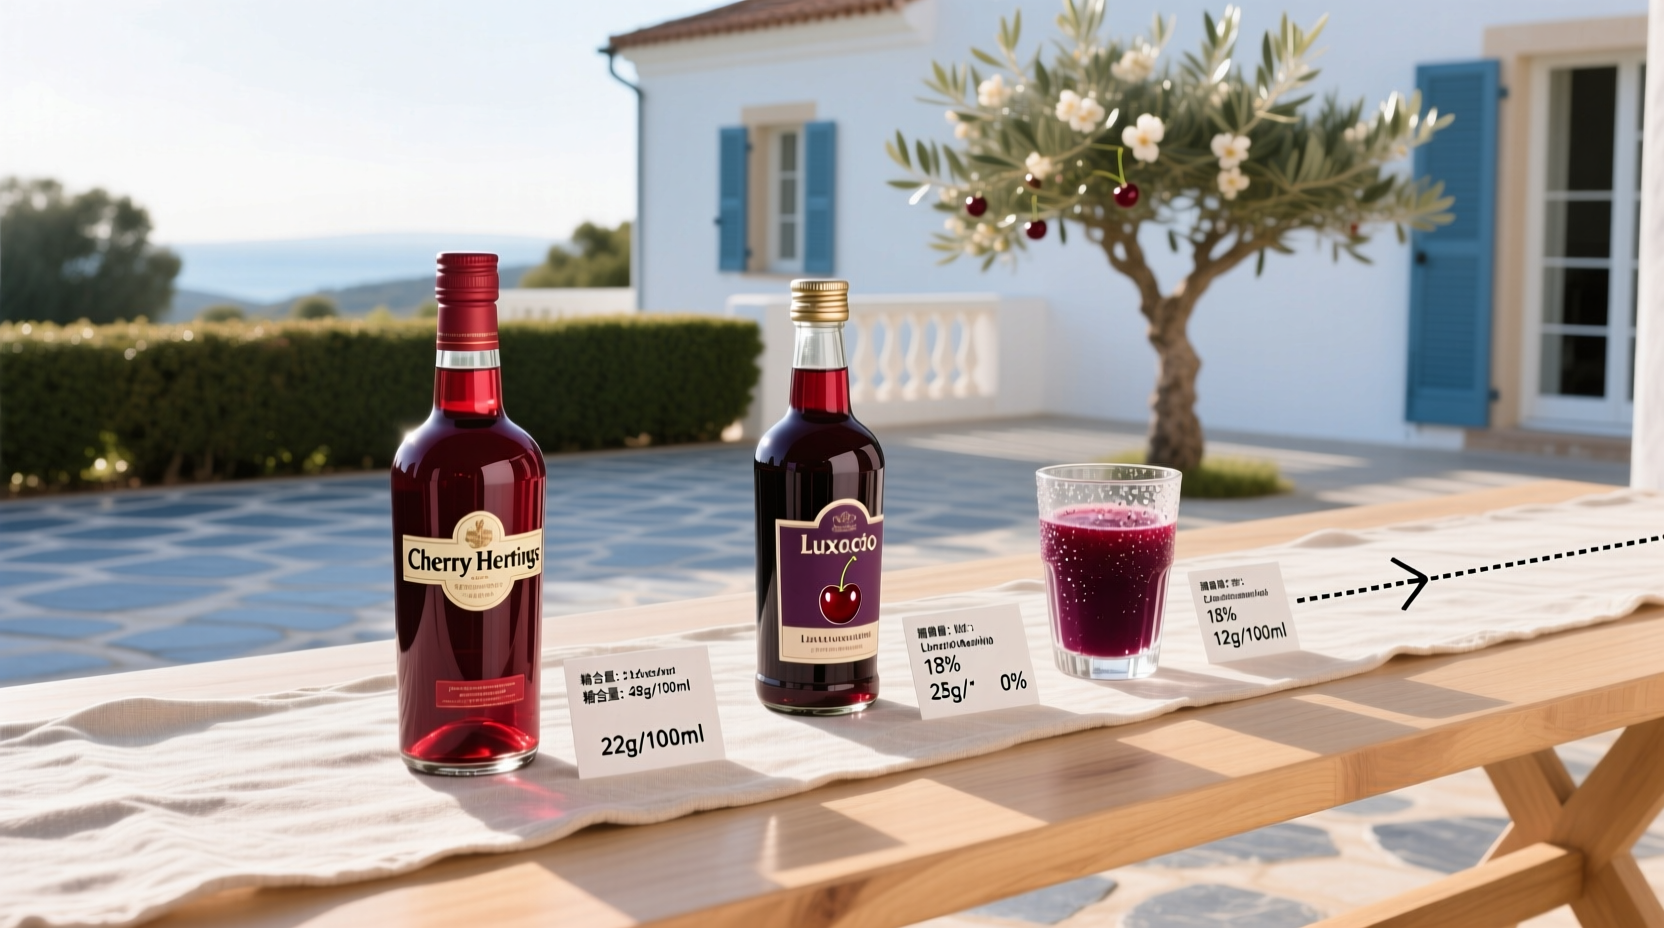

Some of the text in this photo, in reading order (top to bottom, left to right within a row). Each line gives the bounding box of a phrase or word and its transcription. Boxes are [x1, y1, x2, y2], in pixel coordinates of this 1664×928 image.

[408, 548, 472, 578] Cherry
[1207, 606, 1237, 624] 18%
[1214, 621, 1287, 648] 12g/100ml
[924, 655, 961, 675] 18%
[1000, 671, 1027, 691] 0%
[601, 723, 704, 758] 22g/100ml
